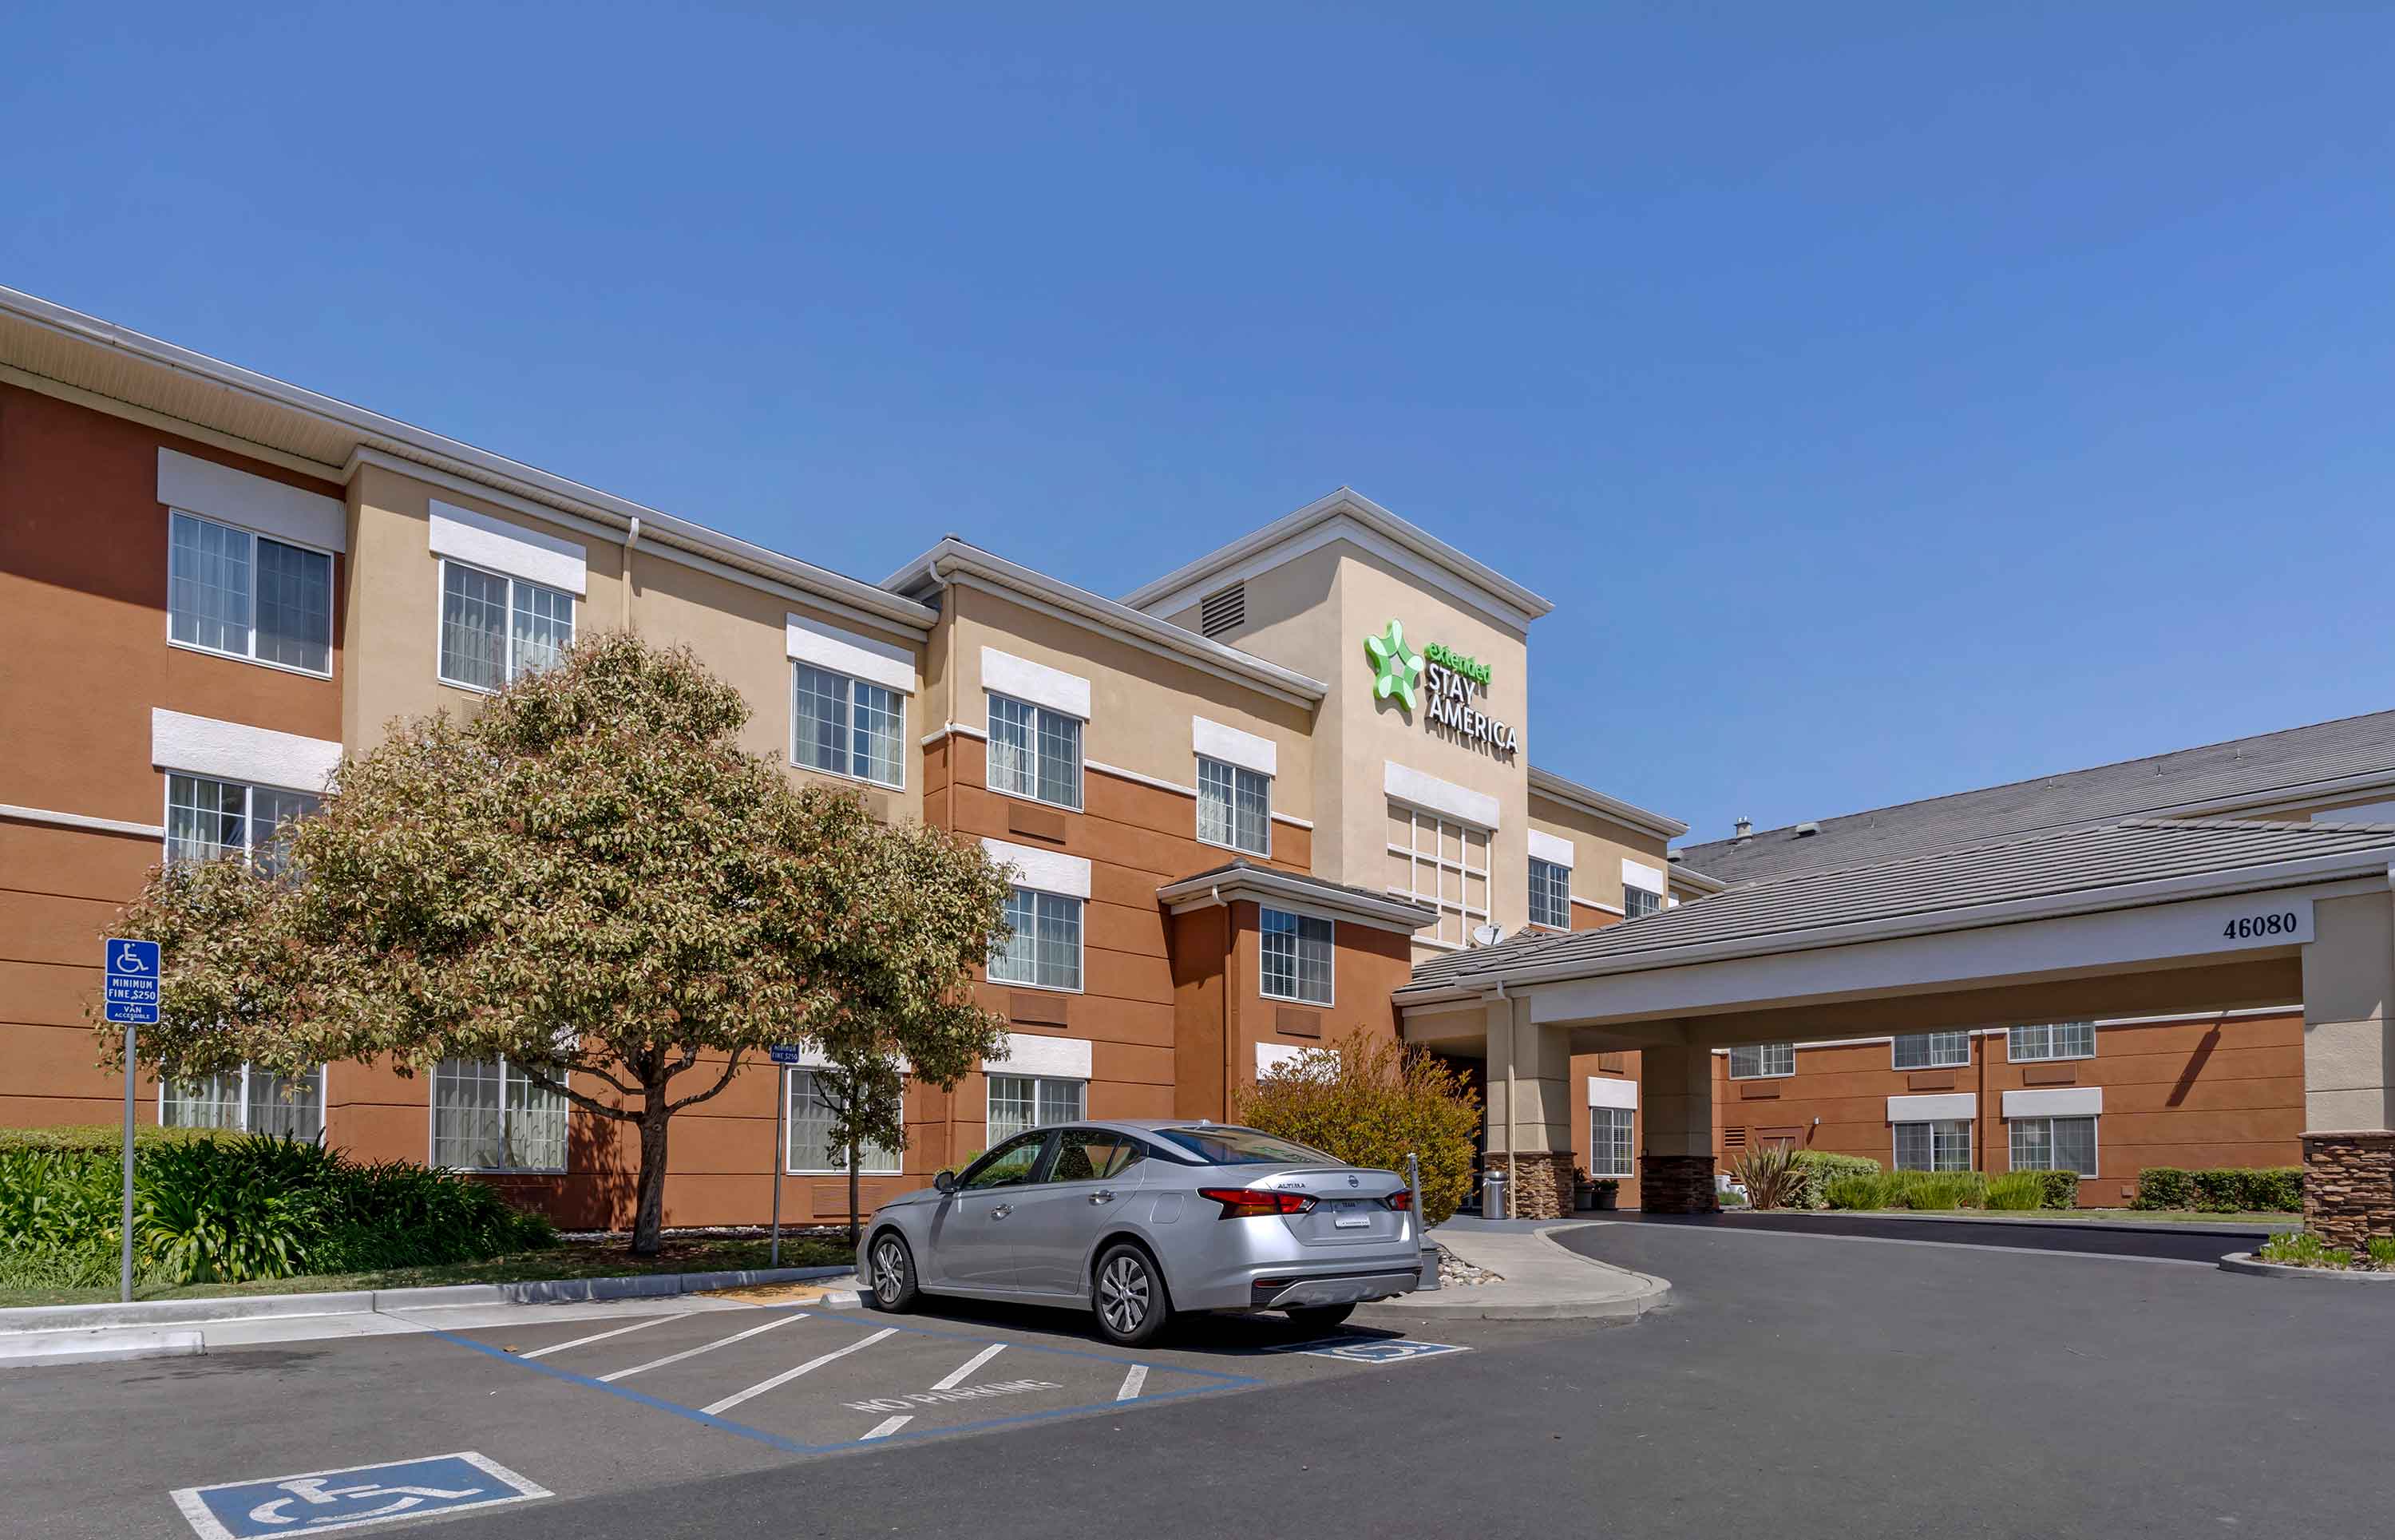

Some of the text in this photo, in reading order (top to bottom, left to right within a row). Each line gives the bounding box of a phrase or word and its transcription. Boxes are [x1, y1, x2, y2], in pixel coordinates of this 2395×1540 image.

[1428, 643, 1491, 685] extended
[1428, 663, 1475, 704] STAY
[1428, 693, 1518, 754] AMERICA
[2223, 913, 2297, 940] 46080
[109, 988, 156, 1000] FINE $250
[113, 978, 152, 989] MINIMUM
[841, 1379, 1063, 1413] NO PARKING
